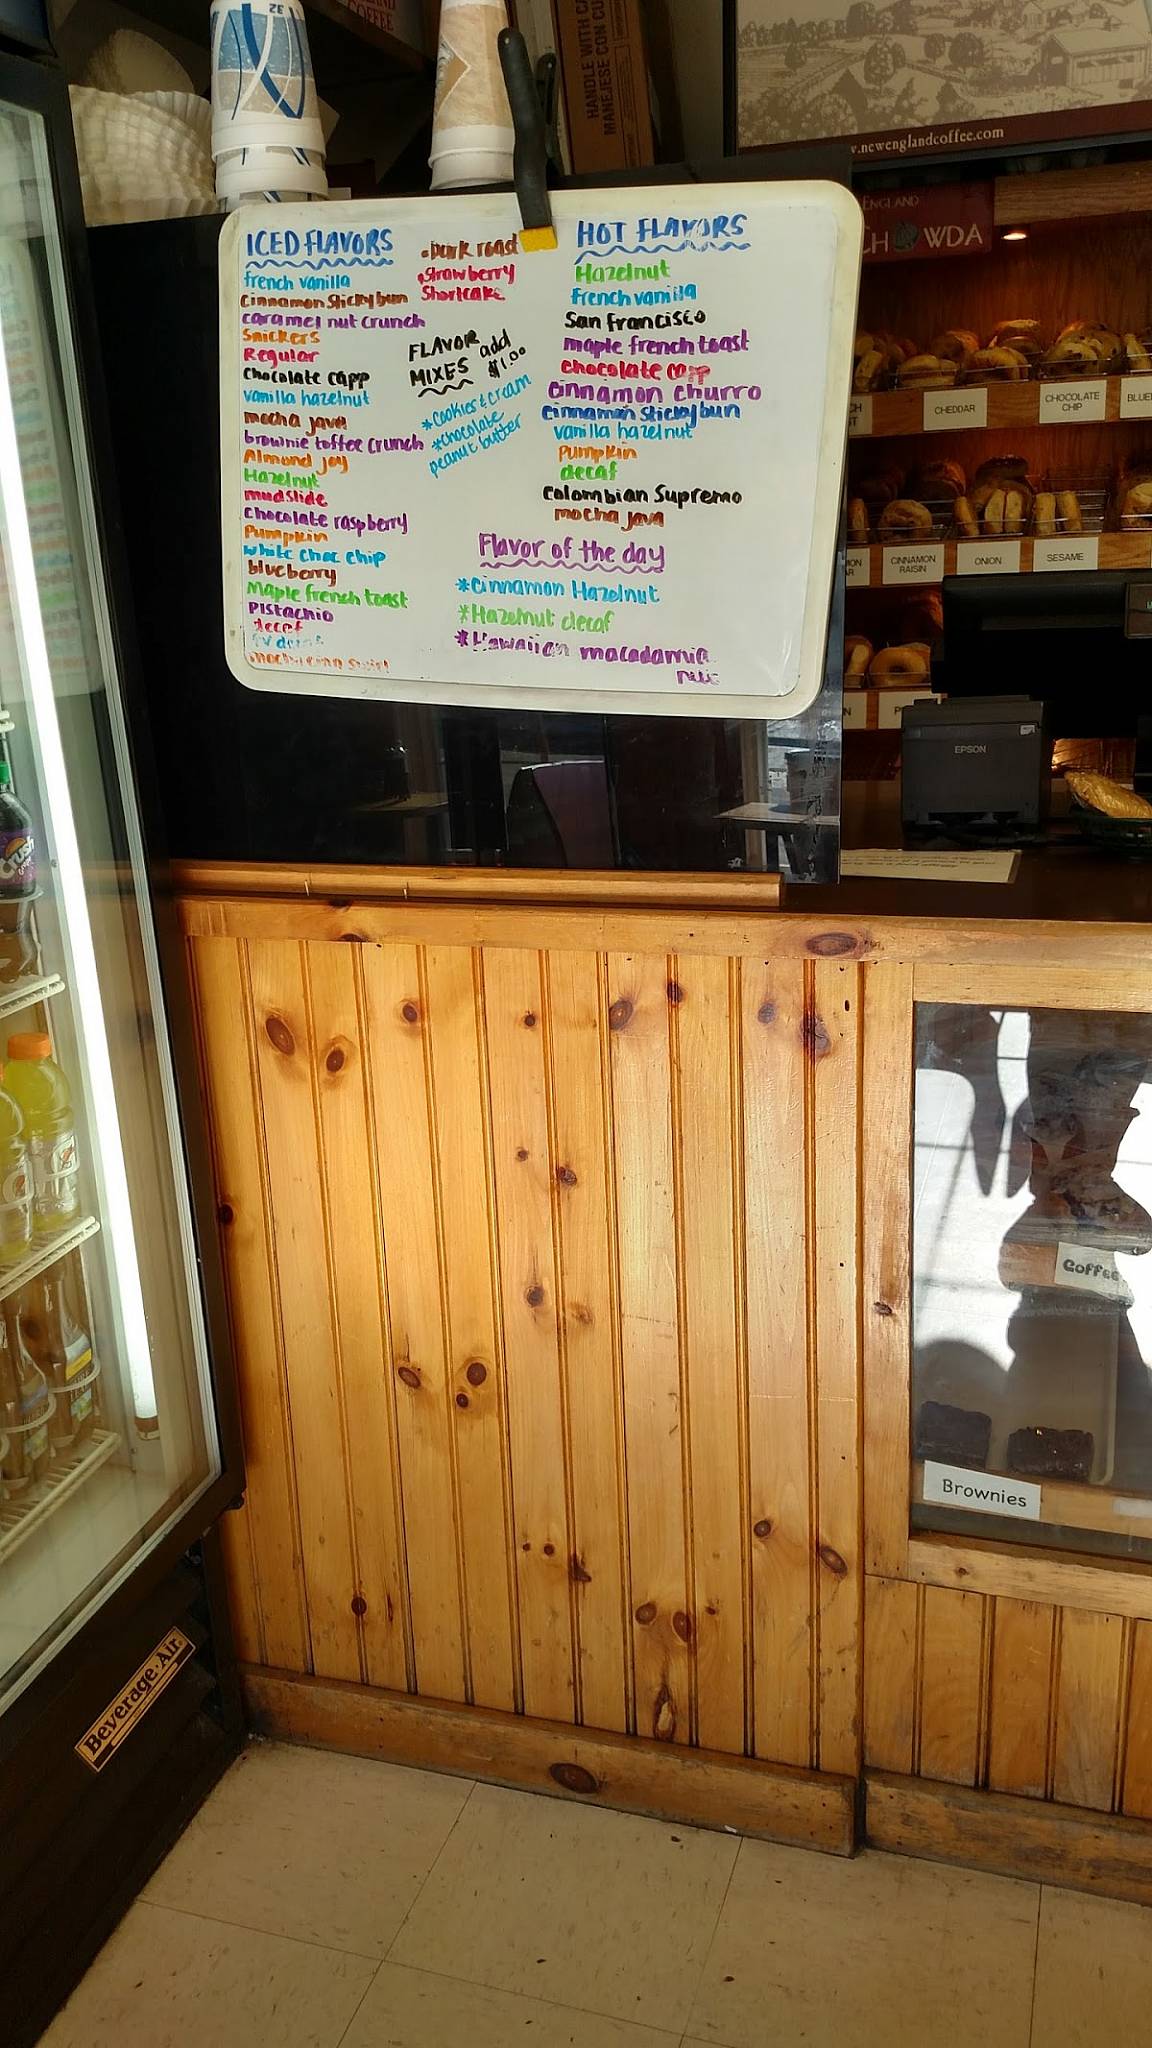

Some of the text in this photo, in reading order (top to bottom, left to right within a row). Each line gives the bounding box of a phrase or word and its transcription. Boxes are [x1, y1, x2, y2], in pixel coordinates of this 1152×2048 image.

[578, 18, 593, 57] WITH
[594, 23, 609, 56] CON
[582, 60, 599, 119] HANDLE
[597, 60, 616, 135] MANEJESE
[862, 194, 920, 211] ENGLAND
[247, 228, 394, 256] ICED FLAVORS
[577, 214, 748, 248] HOT FLAVORS
[299, 273, 350, 290] vanilla
[576, 259, 671, 284] Hazelnut
[633, 284, 697, 306] vanilla
[242, 312, 321, 329] caramel
[327, 313, 358, 329] nut
[564, 309, 706, 332] San Francisco
[242, 329, 320, 345] Snickers
[408, 328, 512, 362] FLAVOR add
[564, 328, 749, 358] maple french toast
[243, 347, 320, 369] Regular
[328, 371, 370, 391] capp
[409, 357, 469, 387] MIXES
[243, 389, 370, 407] vanilla hazelnut
[1045, 391, 1100, 403] CHOCOLATE
[1061, 402, 1083, 413] CHIP
[934, 404, 976, 415] CHEDDAR
[244, 411, 347, 436] mocha java
[554, 422, 693, 441] vanilla hazelnut
[244, 430, 309, 449] brownie
[315, 434, 363, 452] toffee
[429, 413, 521, 479] peanut butter
[243, 449, 312, 468] Almond
[244, 467, 320, 489] Hazelnut
[560, 461, 617, 481] decaf
[244, 489, 328, 507] mudslide
[654, 483, 742, 509] Supremo
[333, 512, 408, 537] raspberry
[554, 507, 665, 531] mocha java
[244, 524, 328, 547] Pumpkin
[243, 543, 293, 560] white
[479, 533, 665, 571] Flavor of the day
[890, 554, 936, 566] CINNAMON
[974, 556, 1002, 566] ONION
[1046, 551, 1084, 563] SESAME
[248, 559, 337, 587] blueberry
[899, 564, 927, 575] RAISIN
[247, 581, 409, 609] Maple french toast
[571, 580, 660, 605] Hazelnut
[471, 604, 615, 634] Hazelnut decaf
[580, 645, 710, 665] macadamia
[954, 745, 987, 754] EPSON
[0, 835, 35, 879] Crush
[1062, 1258, 1120, 1283] Coffee
[942, 1478, 1028, 1508] Brownies
